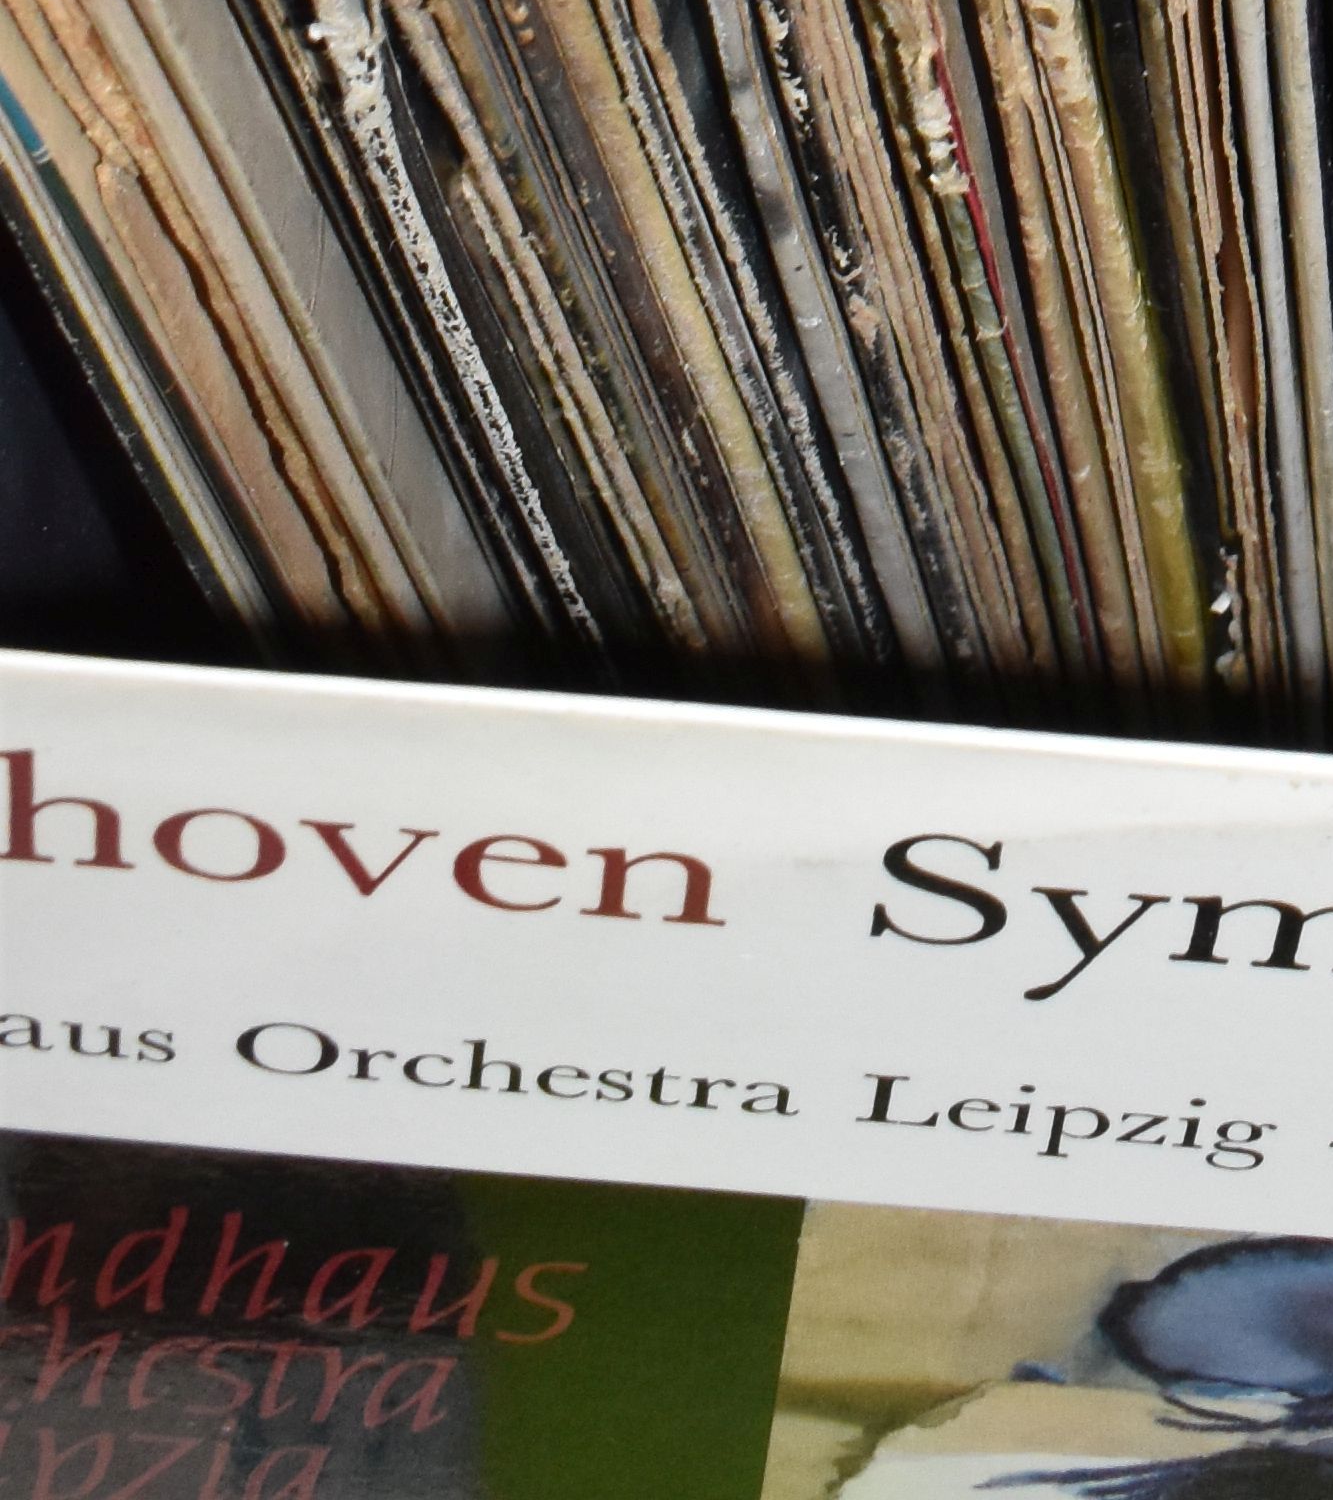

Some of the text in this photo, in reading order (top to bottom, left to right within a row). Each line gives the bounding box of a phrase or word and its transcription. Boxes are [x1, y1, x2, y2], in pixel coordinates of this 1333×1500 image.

[0, 746, 728, 928] hoven
[0, 1013, 178, 1067] aus
[234, 1020, 802, 1121] Orchestra
[861, 1070, 1280, 1172] Leipzig
[0, 1203, 590, 1345] ndhaus
